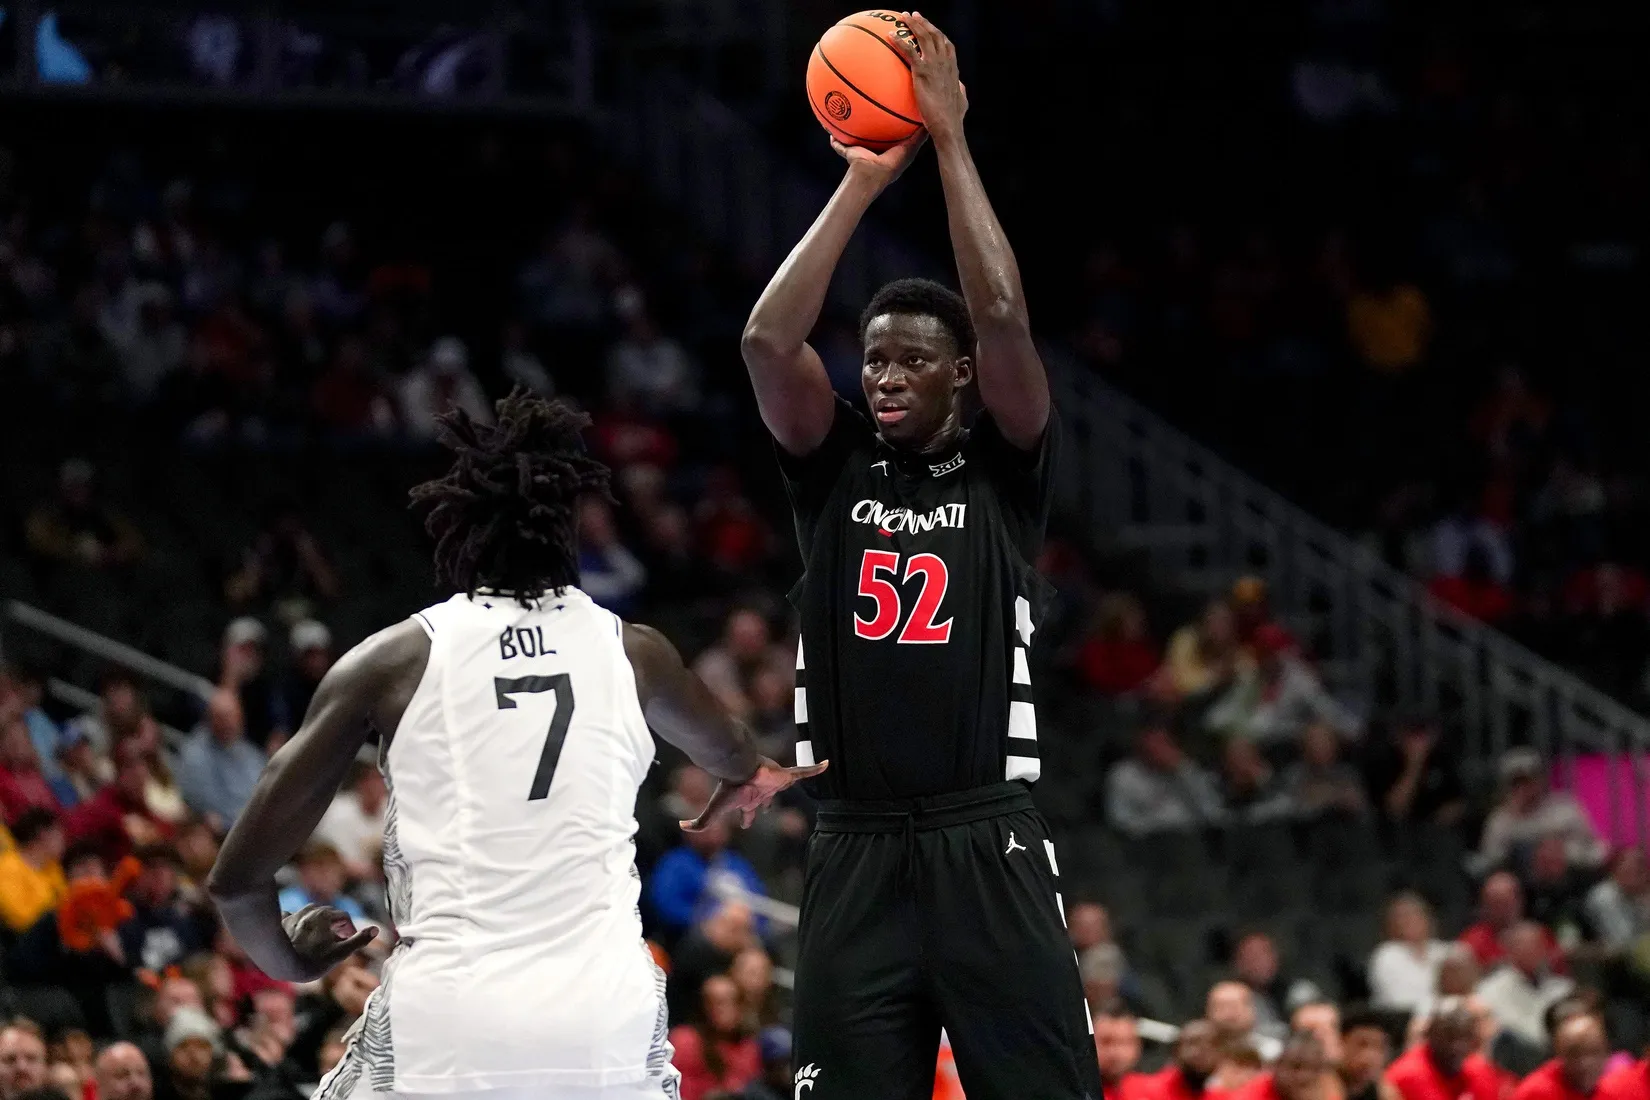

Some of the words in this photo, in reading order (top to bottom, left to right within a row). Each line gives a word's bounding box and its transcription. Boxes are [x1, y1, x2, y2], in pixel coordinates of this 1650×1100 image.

[851, 499, 967, 536] CINCINNATI
[853, 548, 954, 645] 52
[500, 625, 557, 660] BOL
[494, 673, 575, 801] 7
